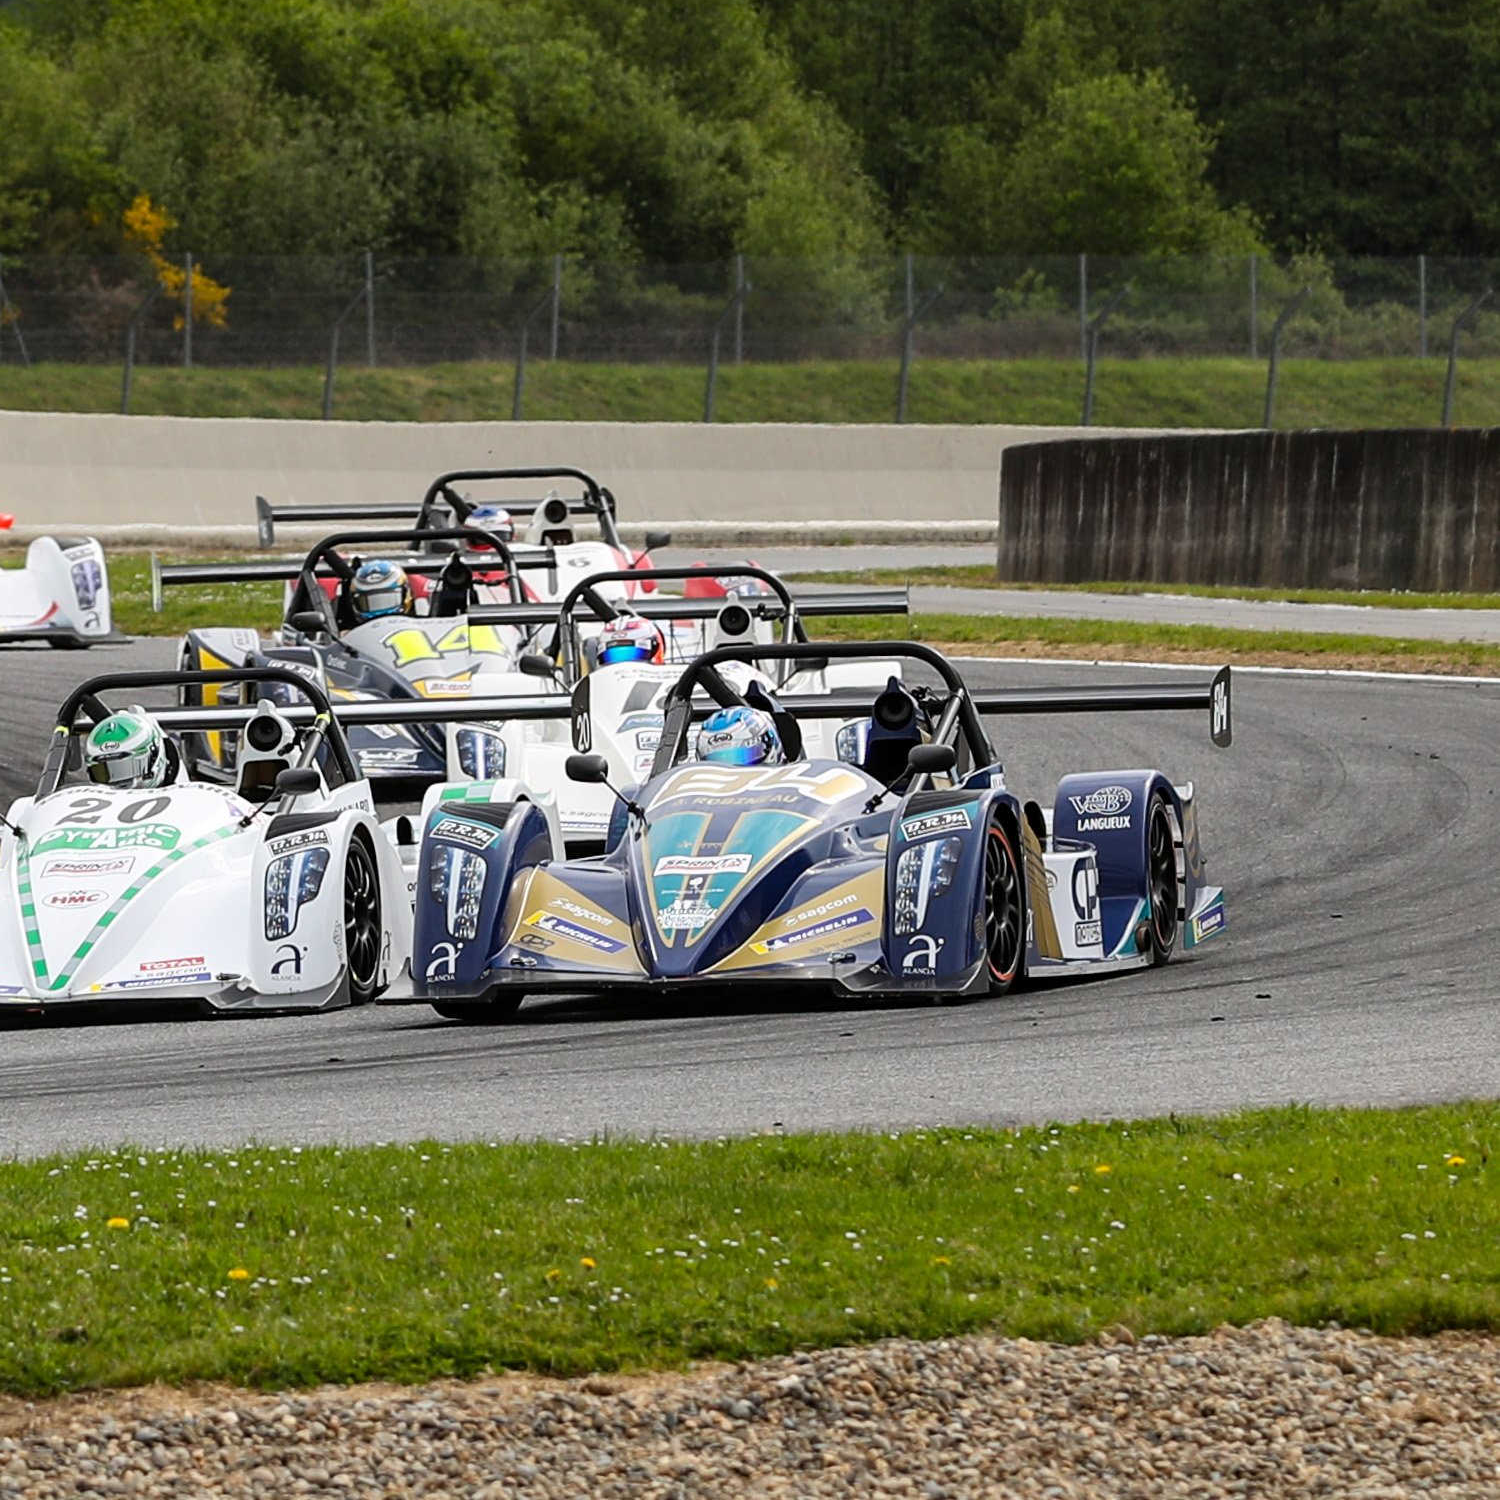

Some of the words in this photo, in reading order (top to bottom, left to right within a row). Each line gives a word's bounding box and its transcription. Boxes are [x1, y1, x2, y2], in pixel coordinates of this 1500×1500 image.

[382, 626, 505, 667] 14
[1213, 681, 1227, 735] 84
[576, 712, 590, 751] 20
[55, 796, 172, 826] 20
[1077, 816, 1131, 831] LANGUEUX
[51, 893, 100, 904] HMC
[556, 924, 613, 948] MICHELIN
[788, 915, 858, 943] MICHELIN
[141, 957, 202, 970] TOTAL
[903, 967, 937, 976] ALANCIA
[126, 974, 198, 987] MICHELIN
